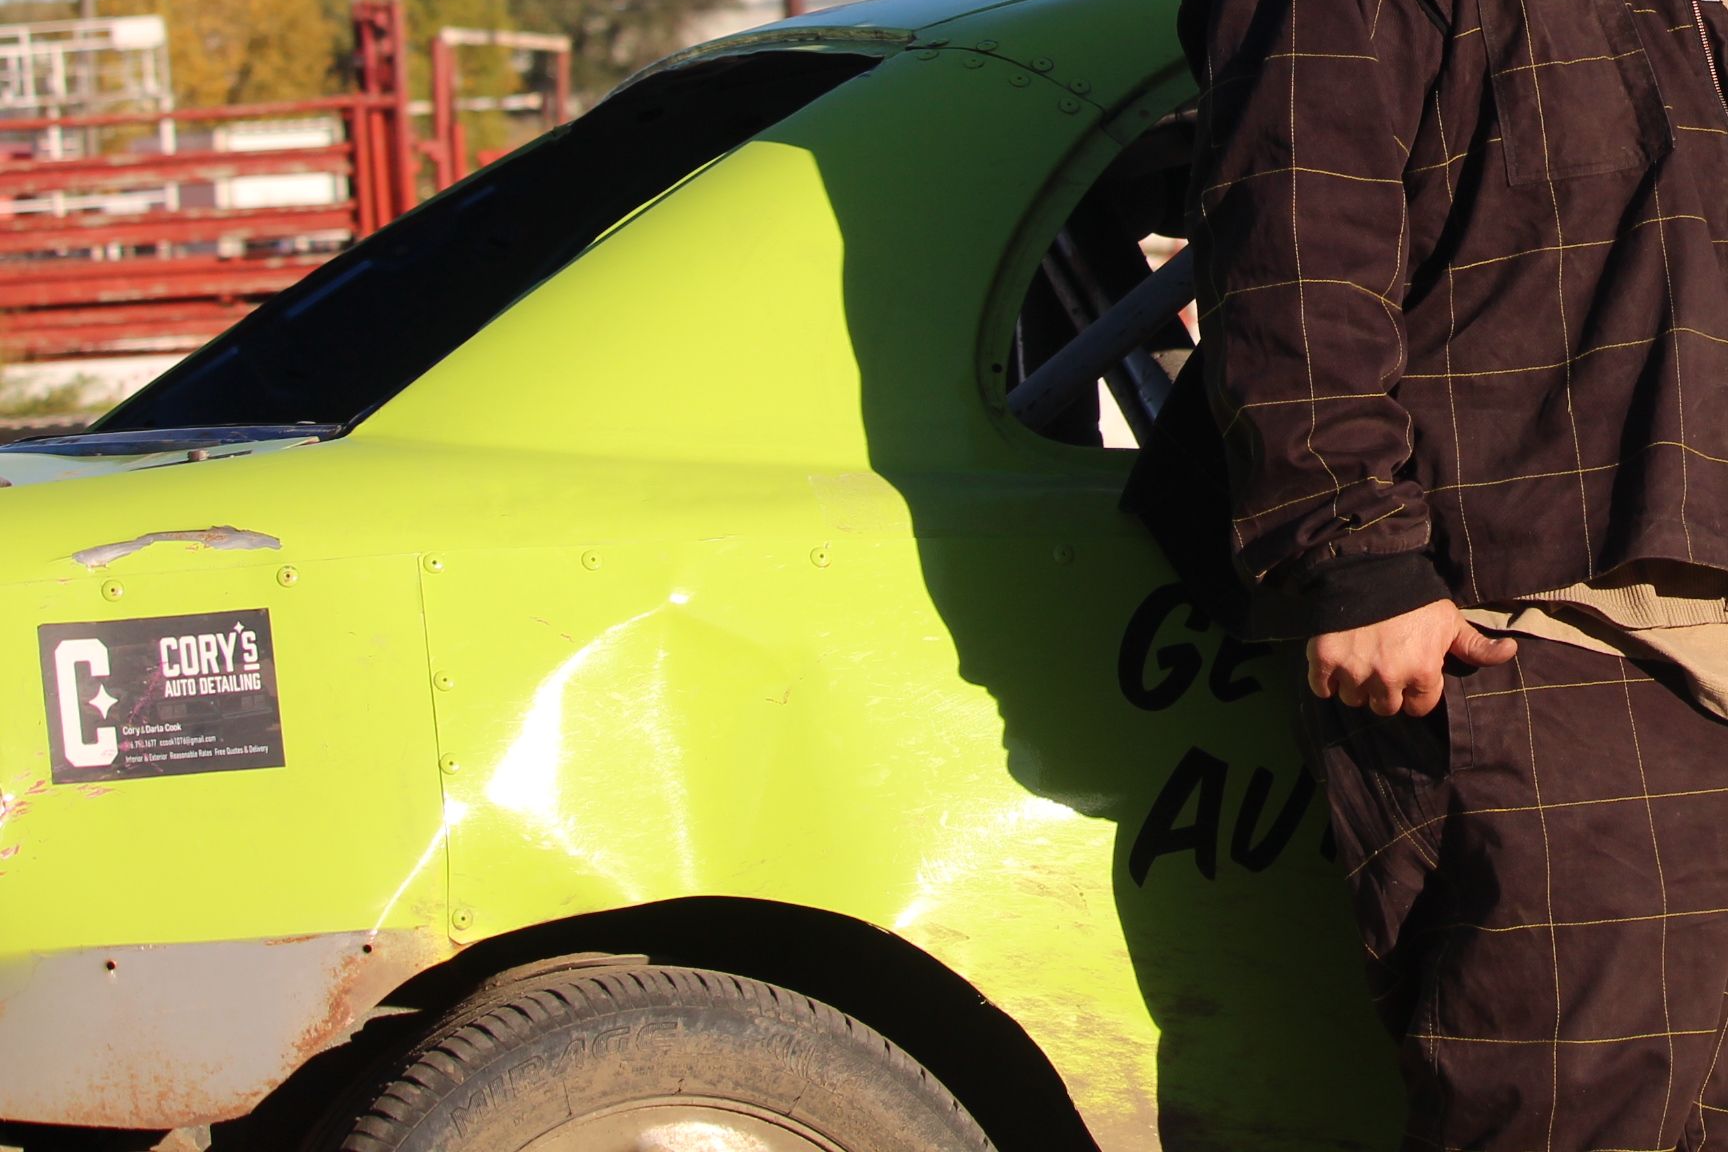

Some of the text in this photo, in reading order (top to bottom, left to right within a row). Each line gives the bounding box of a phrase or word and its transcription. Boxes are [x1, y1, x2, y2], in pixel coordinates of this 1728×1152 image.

[160, 622, 260, 677] CORY'S
[165, 673, 261, 698] AUTO DETAILING
[122, 726, 140, 736] Cory
[145, 724, 163, 734] Darla
[164, 723, 182, 733] Cook
[149, 753, 167, 762] Exterior
[169, 750, 198, 760] Reasonable
[198, 749, 213, 757] Rates
[214, 747, 226, 756] Free
[226, 746, 243, 755] Quotes
[248, 744, 269, 754] Delivery
